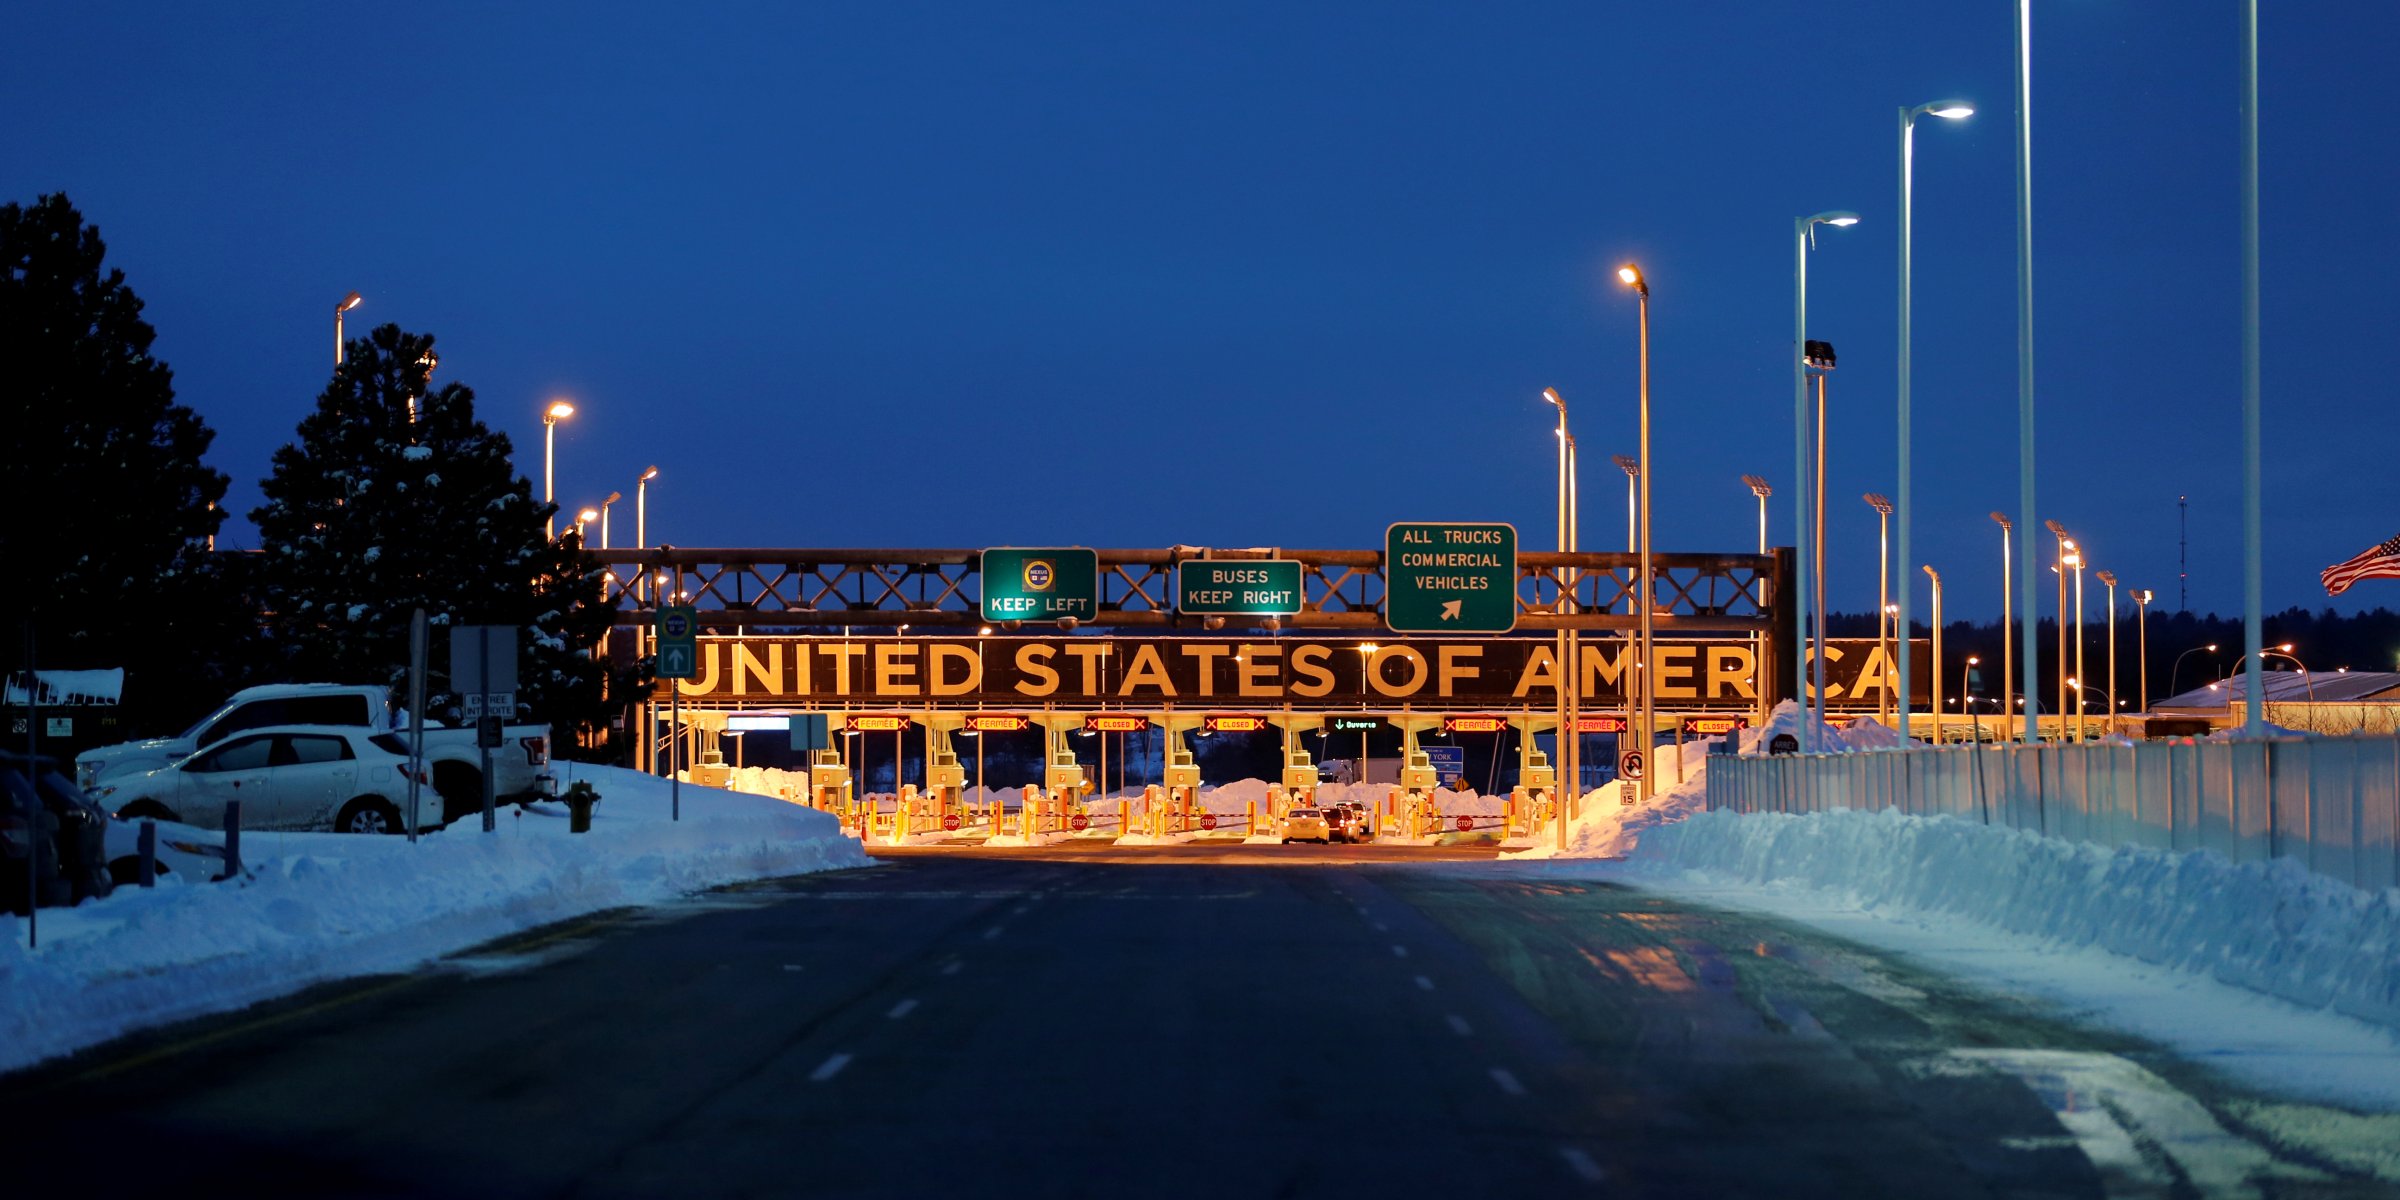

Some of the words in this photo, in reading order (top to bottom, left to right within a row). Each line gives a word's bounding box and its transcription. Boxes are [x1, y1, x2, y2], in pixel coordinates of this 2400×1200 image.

[1402, 530, 1433, 543] ALL
[1444, 530, 1502, 544] TRUCKS
[1402, 553, 1502, 567] COMMERCIAL
[1212, 570, 1269, 583] BUSES
[1415, 576, 1489, 590] VEHICLES
[1189, 591, 1233, 604] KEEP
[1243, 591, 1292, 604] RIGHT
[991, 598, 1036, 611] KEEP
[1046, 598, 1088, 611] LEFT
[673, 643, 983, 696] UNITED
[1014, 643, 1336, 697] STATES
[1367, 645, 1483, 697] OF
[1511, 645, 1903, 699] AMERCA
[467, 706, 513, 715] INTDITE
[860, 718, 894, 728] FERMÉE
[980, 718, 1014, 728] FERMÉE
[1346, 721, 1376, 729] Ouverte
[1458, 719, 1492, 729] FERMÉE
[1578, 719, 1612, 729] FERMÉE
